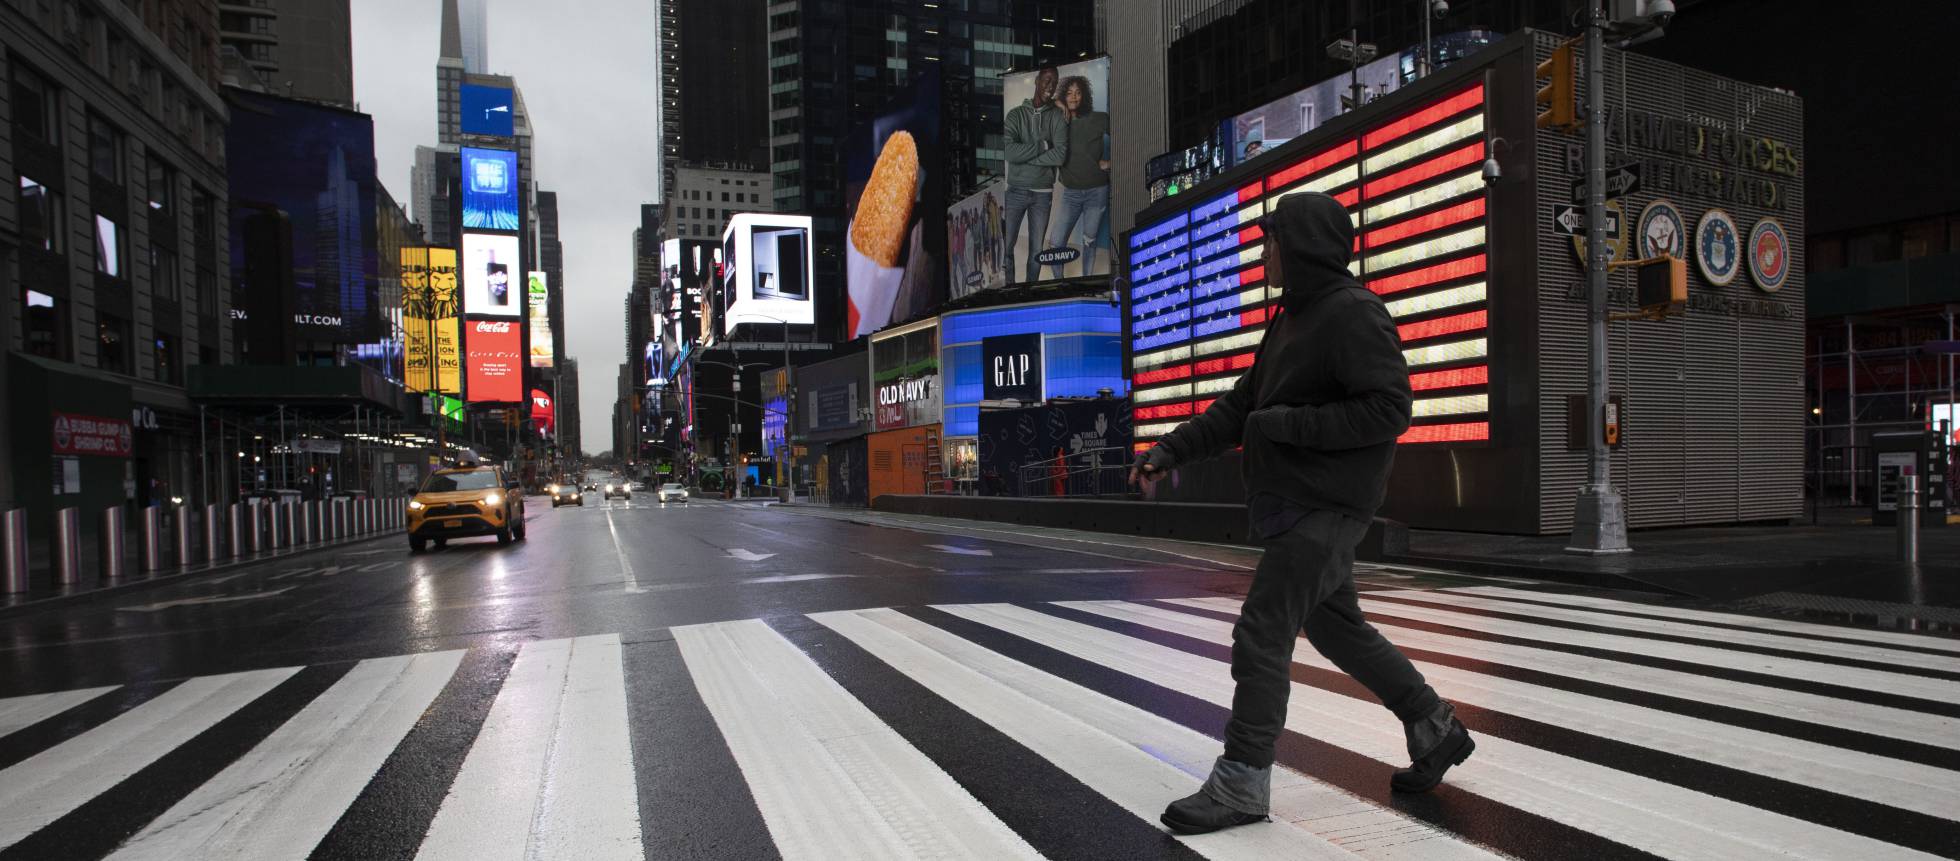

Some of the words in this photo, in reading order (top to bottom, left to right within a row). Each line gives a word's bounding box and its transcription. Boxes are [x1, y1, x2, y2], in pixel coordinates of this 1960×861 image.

[1706, 126, 1797, 176] FORCES
[1563, 214, 1583, 227] ONE
[1039, 253, 1054, 262] OLD
[1054, 250, 1075, 260] NAVY
[438, 358, 458, 366] ING
[994, 353, 1029, 388] GAP
[880, 385, 898, 405] OLD
[898, 380, 925, 403] NAVY
[70, 418, 97, 434] BUBBA
[97, 421, 120, 437] GUMP
[74, 435, 104, 450] SHRIMP
